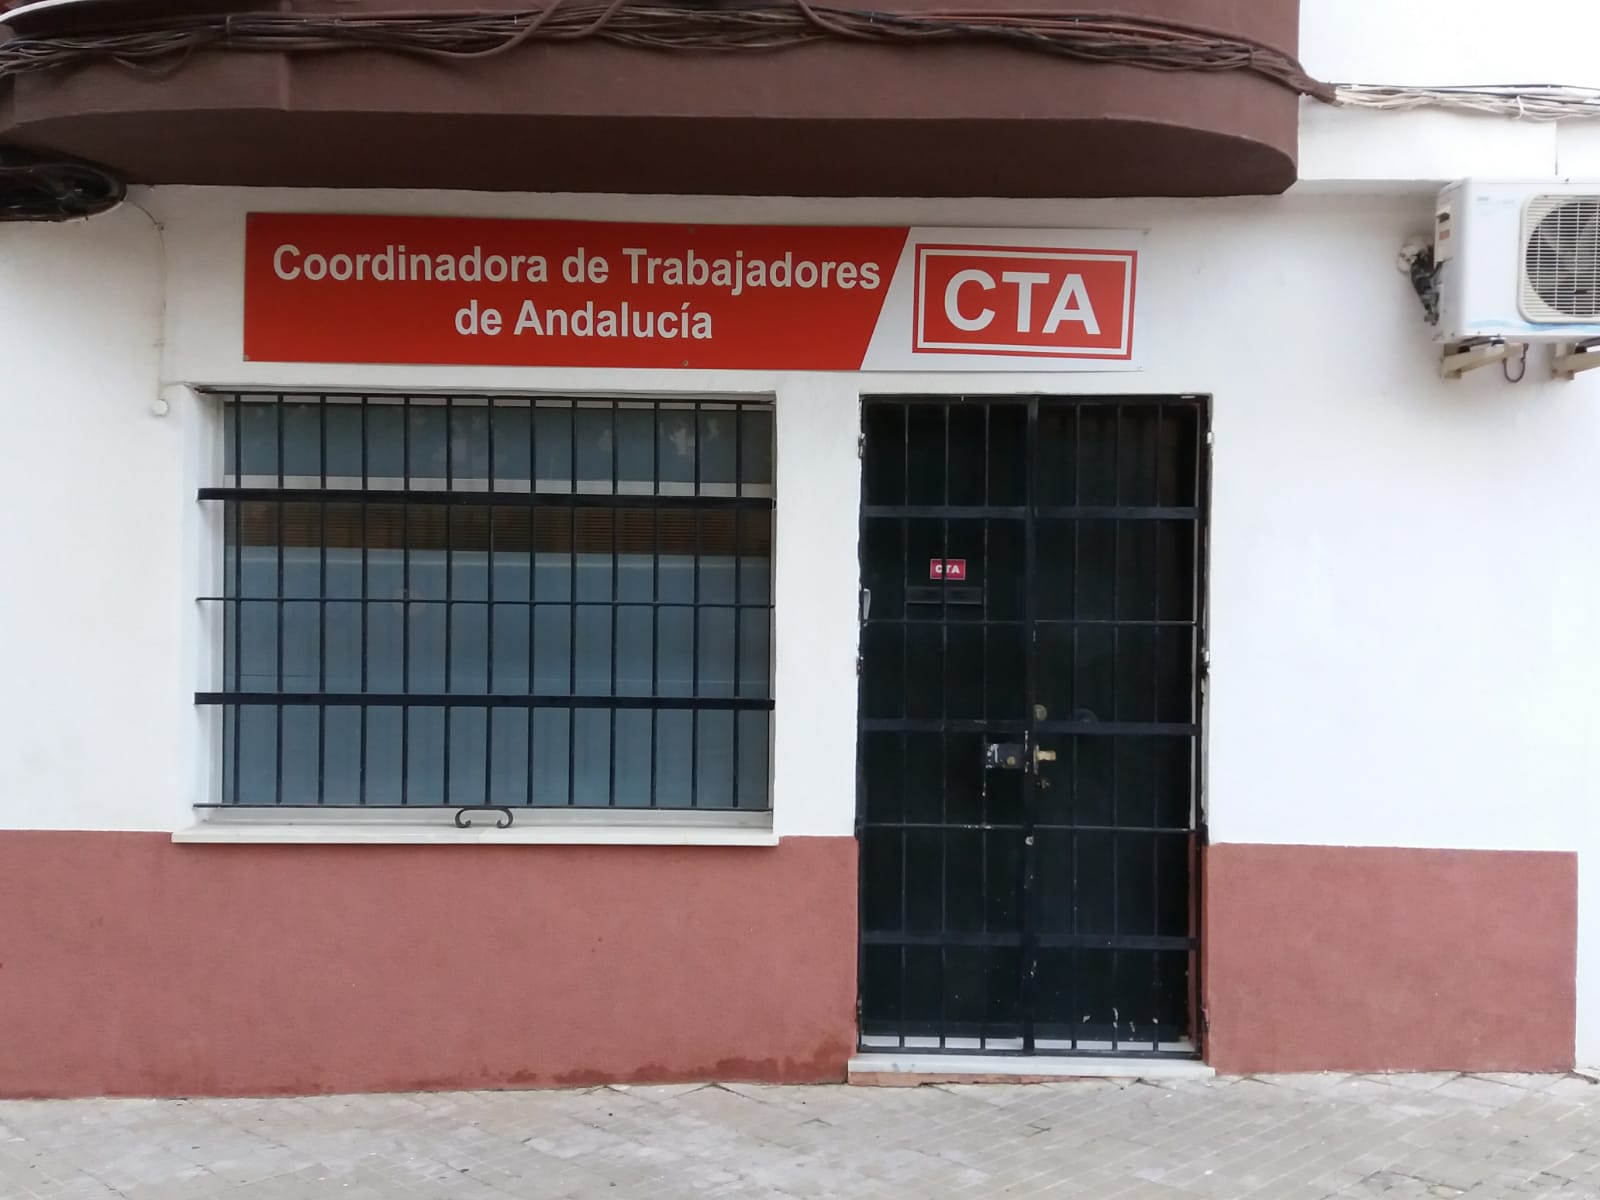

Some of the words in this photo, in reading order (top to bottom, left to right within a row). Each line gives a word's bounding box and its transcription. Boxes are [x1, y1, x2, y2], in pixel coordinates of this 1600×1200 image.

[272, 244, 549, 284] Coordinadora
[561, 247, 609, 285] de
[622, 247, 881, 296] Trabajadores
[454, 300, 503, 336] de
[513, 300, 713, 339] Andalucía
[944, 269, 1101, 335] CTA
[935, 564, 960, 574] CTA
